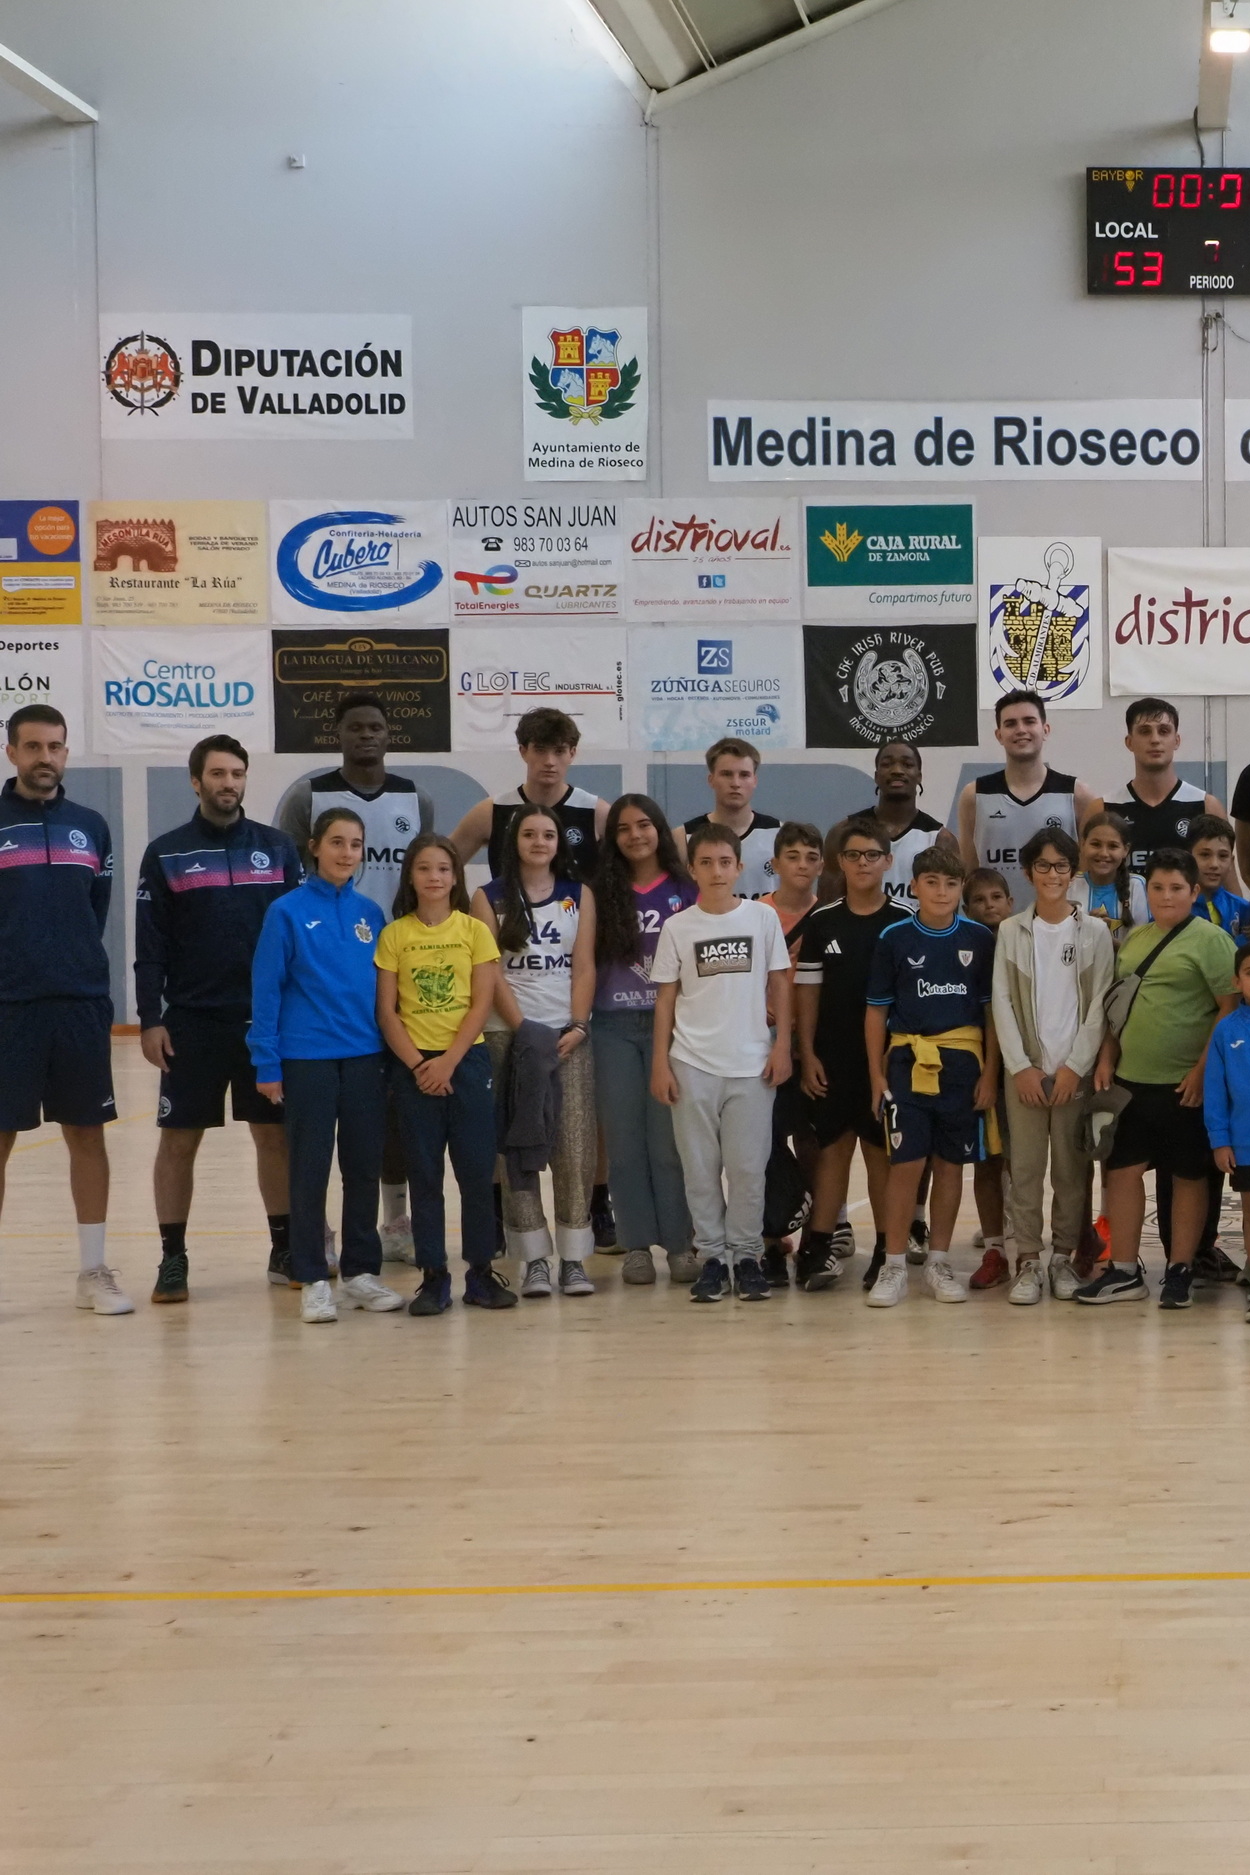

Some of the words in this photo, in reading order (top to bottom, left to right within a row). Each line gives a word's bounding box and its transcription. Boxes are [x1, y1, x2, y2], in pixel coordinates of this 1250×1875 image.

[1095, 222, 1158, 238] LOCAL
[1114, 252, 1164, 286] 53
[1190, 276, 1234, 289] PERIODO
[191, 340, 402, 378] DIPUTACIÓN
[191, 393, 226, 414] DE
[237, 386, 406, 415] VALLADOLID
[533, 442, 621, 455] Ayuntamiento
[625, 442, 640, 453] de
[712, 416, 896, 467] Medina
[914, 416, 975, 467] de
[994, 417, 1203, 467] Rioseco
[529, 458, 575, 469] Medina
[579, 458, 594, 469] de
[598, 458, 643, 468] Rioseco
[453, 506, 517, 527] AUTOS
[524, 506, 561, 527] SAN
[568, 505, 615, 527] JUAN
[139, 529, 150, 537] LA
[514, 537, 535, 551] 983
[539, 538, 552, 551] 70
[557, 538, 570, 551] 03
[575, 537, 588, 551] 64
[867, 536, 905, 550] CAJA
[909, 536, 961, 549] RURAL
[313, 539, 392, 579] Cubero
[869, 553, 882, 561] DE
[887, 553, 930, 561] ZAMORA
[109, 577, 180, 588] Restaurante
[525, 585, 617, 598] QUARTZ
[869, 592, 937, 606] Compartimos
[939, 591, 971, 605] futuro
[455, 602, 519, 611] TotalEnergies
[556, 601, 616, 609] LUBRICANTES
[1033, 614, 1050, 668] ALMIRANTES
[284, 655, 299, 665] LA
[303, 655, 352, 665] FRAGUA
[357, 655, 374, 664] DE
[377, 655, 439, 664] VULCANO
[701, 648, 729, 667] ZS
[890, 632, 925, 652] RIVER
[926, 652, 944, 676] PUB
[144, 659, 215, 680] Centro
[461, 672, 550, 691] GLOTEC
[386, 691, 421, 701] VINOS
[393, 707, 432, 717] COPAS
[727, 719, 766, 727] ZSEGUR
[736, 727, 770, 735] motard
[700, 942, 748, 958] JACK&
[917, 979, 967, 997] Kutxabank
